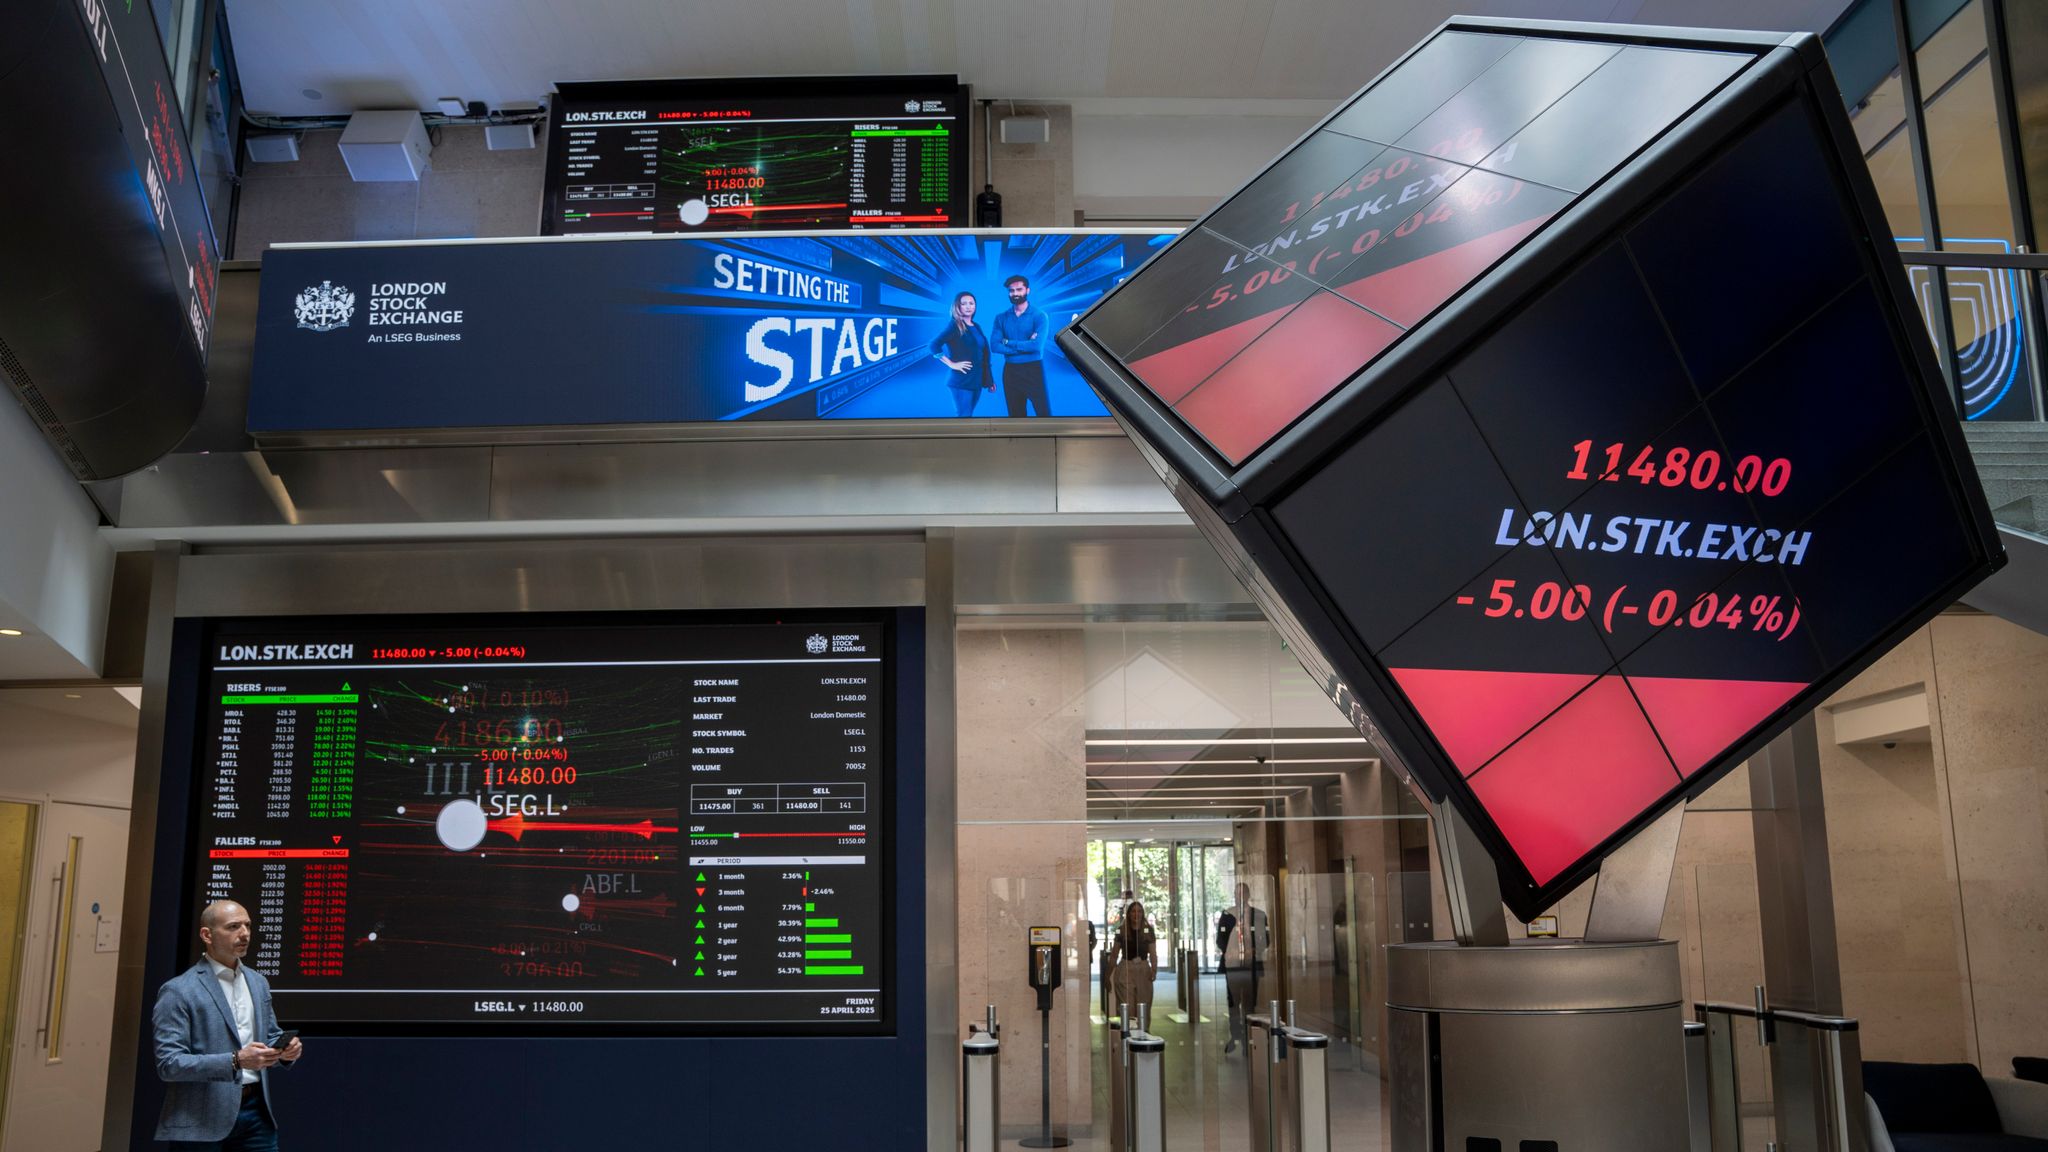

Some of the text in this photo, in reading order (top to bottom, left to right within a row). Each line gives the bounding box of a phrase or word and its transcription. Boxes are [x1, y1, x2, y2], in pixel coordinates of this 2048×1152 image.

[566, 111, 646, 121] LON.STK.EXCH
[706, 177, 764, 190] 11480.00
[714, 253, 822, 300] SETTING
[824, 279, 850, 304] THE
[372, 283, 446, 296] LONDON
[370, 297, 428, 310] STOCK
[370, 311, 464, 324] EXCHANGE
[384, 333, 412, 342] LSEG
[416, 333, 462, 341] Business
[744, 317, 898, 402] STAGE
[1566, 439, 1793, 498] 11480.00
[1494, 507, 1813, 567] LON.STK.EXCH
[220, 645, 354, 660] LON.STK.EXCH
[372, 649, 426, 658] 11480.00
[226, 682, 262, 692] RISERS
[481, 767, 578, 787] 11480.00
[476, 794, 562, 817] LSEG.L
[214, 836, 256, 846] FALLERS
[582, 873, 642, 894] ABF.L
[474, 1001, 516, 1012] LSEG.L
[534, 1002, 584, 1012] 11480.00
